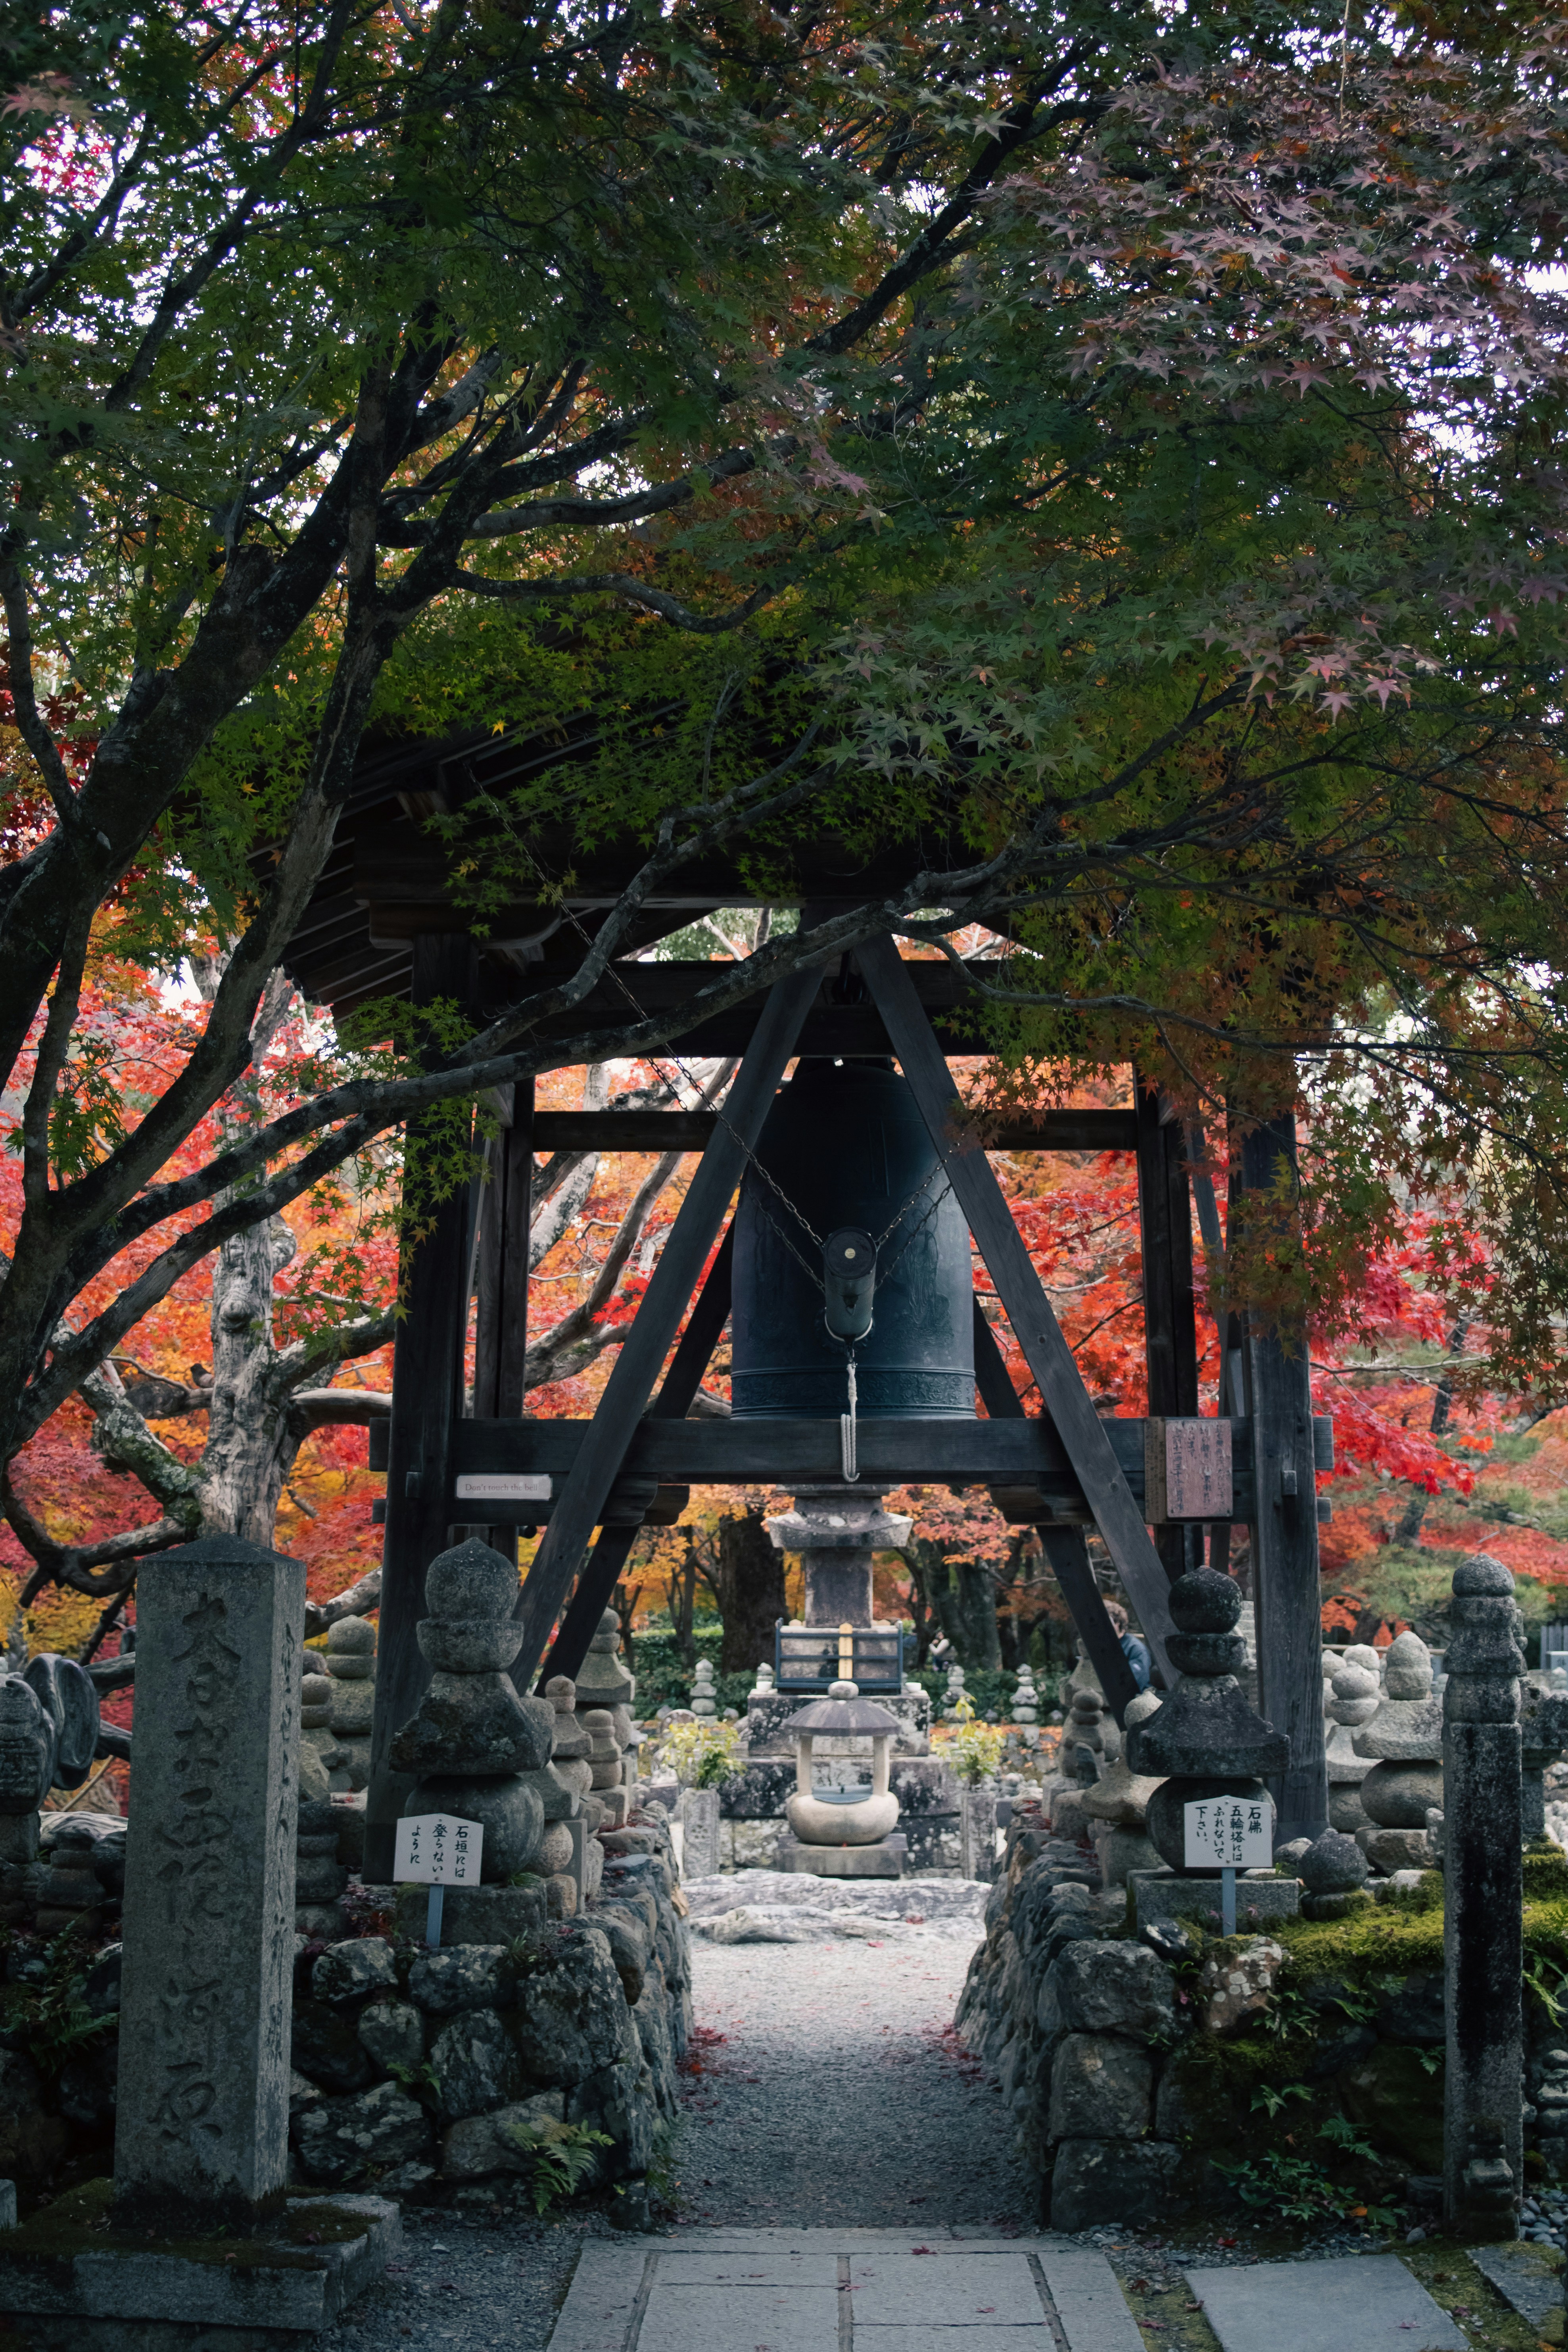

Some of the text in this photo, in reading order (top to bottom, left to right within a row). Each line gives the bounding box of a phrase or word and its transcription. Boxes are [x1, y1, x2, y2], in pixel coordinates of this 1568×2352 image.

[410, 1824, 421, 1864] ように
[1195, 1806, 1208, 1842] 下さい。
[1214, 1806, 1224, 1859] ふれないで
[1230, 1805, 1245, 1861] 五輪塔には
[1248, 1807, 1262, 1834] 石佛
[432, 1823, 448, 1872] 登らない
[455, 1826, 469, 1878] 石垣には
